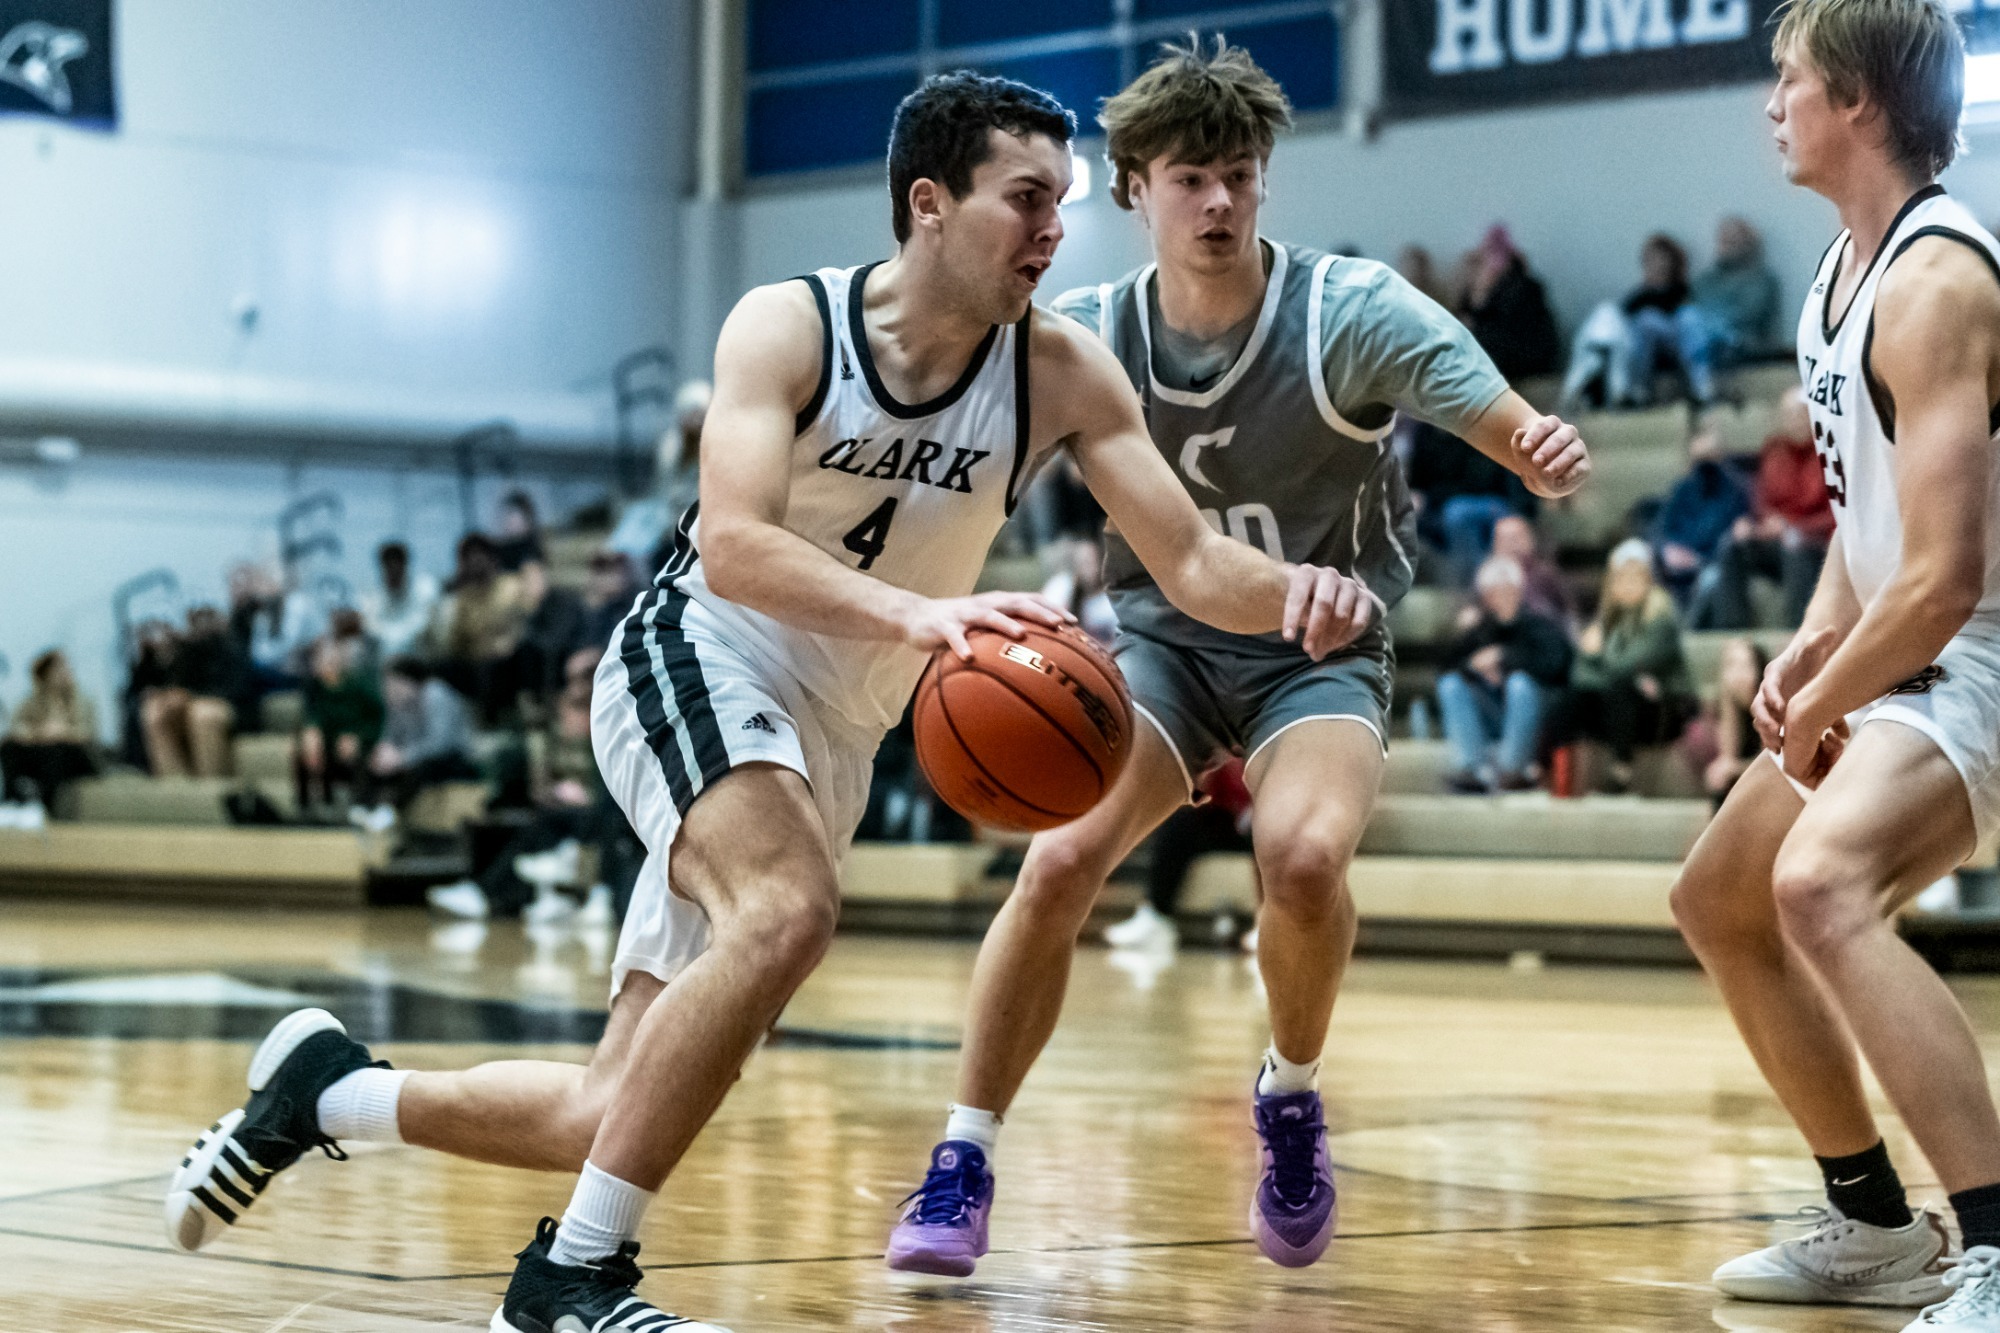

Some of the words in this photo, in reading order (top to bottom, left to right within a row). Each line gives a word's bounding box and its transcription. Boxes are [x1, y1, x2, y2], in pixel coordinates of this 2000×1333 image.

[1428, 0, 1750, 75] HOME
[818, 438, 990, 494] CLARK
[842, 496, 898, 570] 4
[1200, 503, 1284, 562] 0
